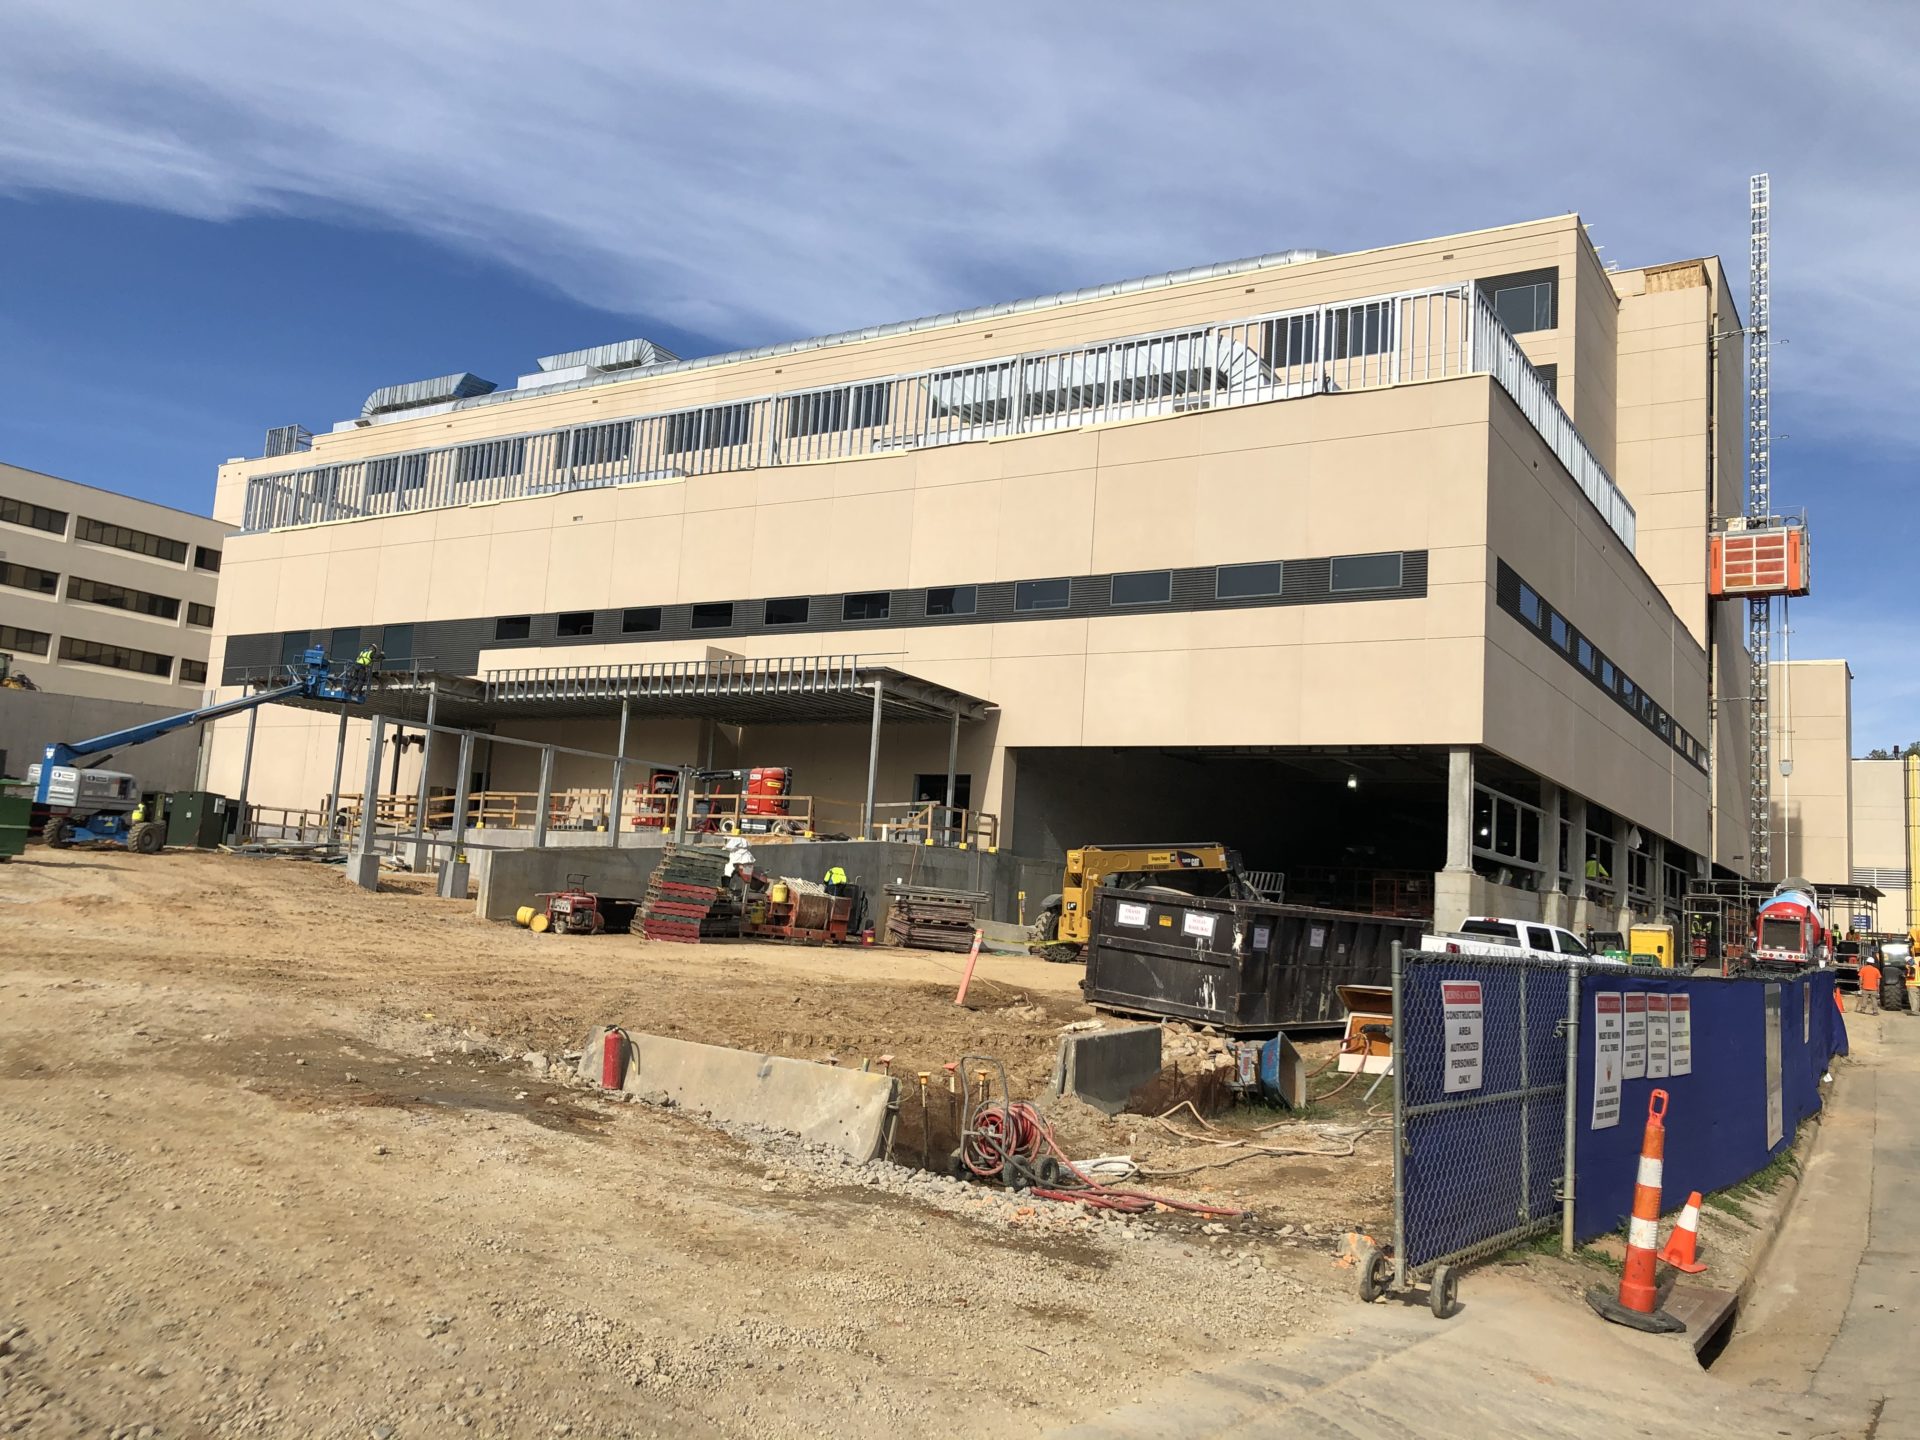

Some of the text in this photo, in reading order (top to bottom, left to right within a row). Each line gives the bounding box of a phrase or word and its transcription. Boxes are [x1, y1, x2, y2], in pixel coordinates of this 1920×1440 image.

[1446, 1010, 1482, 1020] CONSTRUCTION
[1459, 1026, 1471, 1035] AREA
[1450, 1042, 1479, 1052] AUTHORIZED
[1451, 1058, 1478, 1069] PERSONNEL
[1458, 1075, 1471, 1084] ONLY
